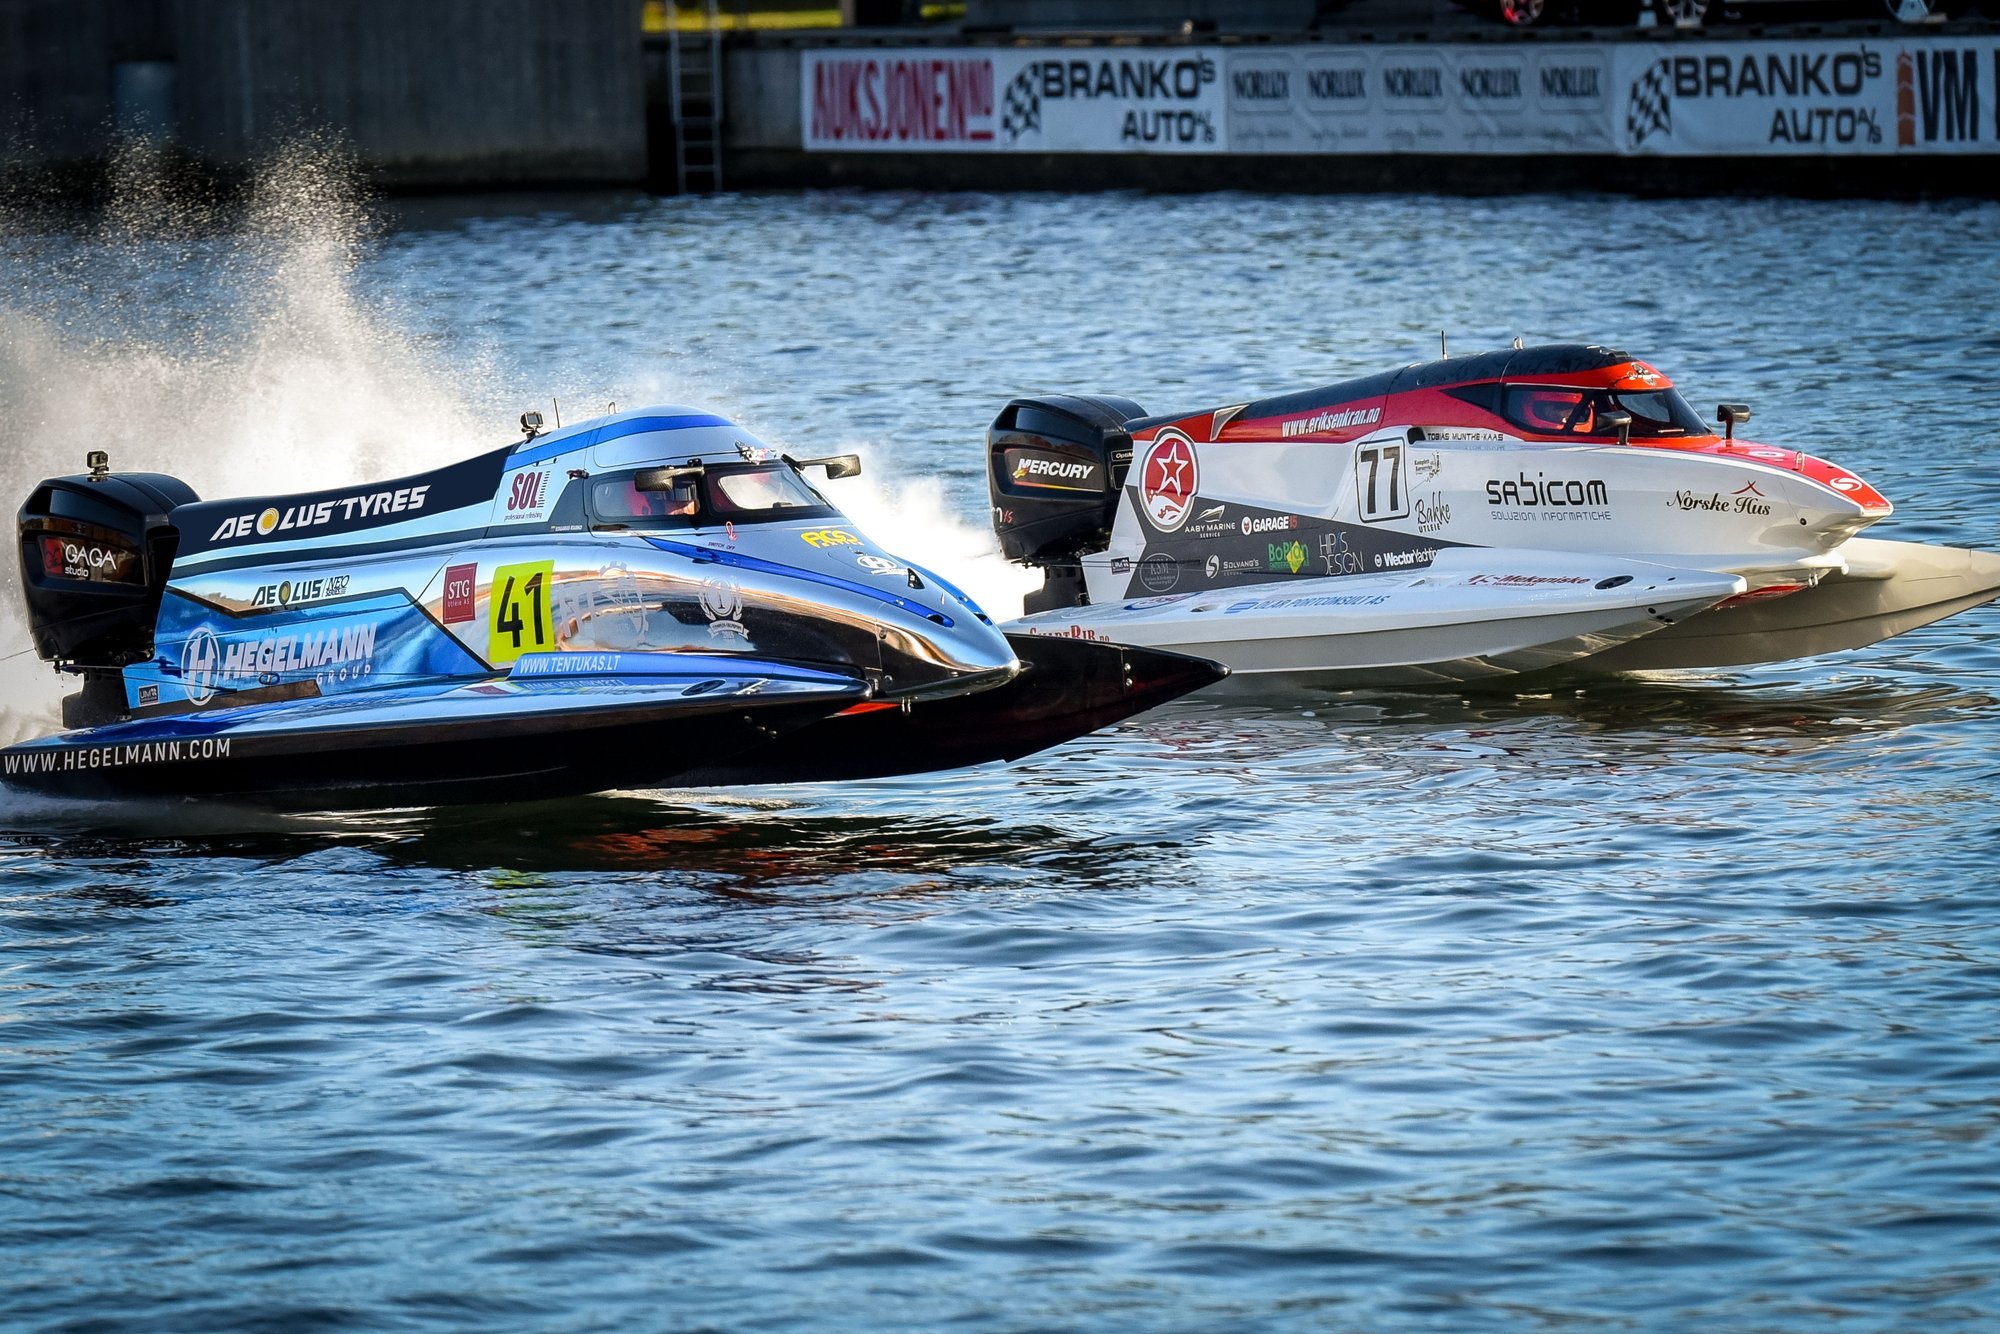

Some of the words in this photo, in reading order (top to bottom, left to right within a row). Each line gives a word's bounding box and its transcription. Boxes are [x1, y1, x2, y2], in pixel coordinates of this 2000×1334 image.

[1234, 70, 1290, 99] NORLUX
[1308, 69, 1366, 98] NORLUX
[1384, 67, 1443, 97] NORLUX
[1461, 68, 1522, 97] NORLUX
[1540, 67, 1599, 96] NORLUX
[1916, 50, 1979, 142] VM
[1122, 110, 1196, 142] AUTO
[1770, 108, 1857, 143] AUTO
[1282, 407, 1381, 437] www.eriksenkran.no
[1427, 433, 1450, 441] TOBIAS
[1013, 458, 1094, 479] MERCURY
[1361, 446, 1400, 514] 77
[337, 484, 431, 520] TYRES
[507, 471, 543, 511] SOL
[1666, 490, 1730, 512] Norske
[1733, 496, 1771, 515] Hus
[1415, 491, 1451, 525] Bakke
[1184, 525, 1206, 533] AABY
[1206, 522, 1236, 532] MARINE
[1418, 522, 1441, 533] UTLEIE
[65, 544, 117, 570] GAGA
[65, 566, 89, 577] studio
[1383, 547, 1439, 568] WectorYachtin
[448, 580, 470, 599] STG
[497, 572, 544, 648] 41
[224, 622, 377, 680] HEGELMANN
[520, 655, 621, 674] WWW.TENTUKAS.LT
[315, 663, 372, 684] GROUP
[4, 738, 231, 774] WWW.HEGELMANN.COM
